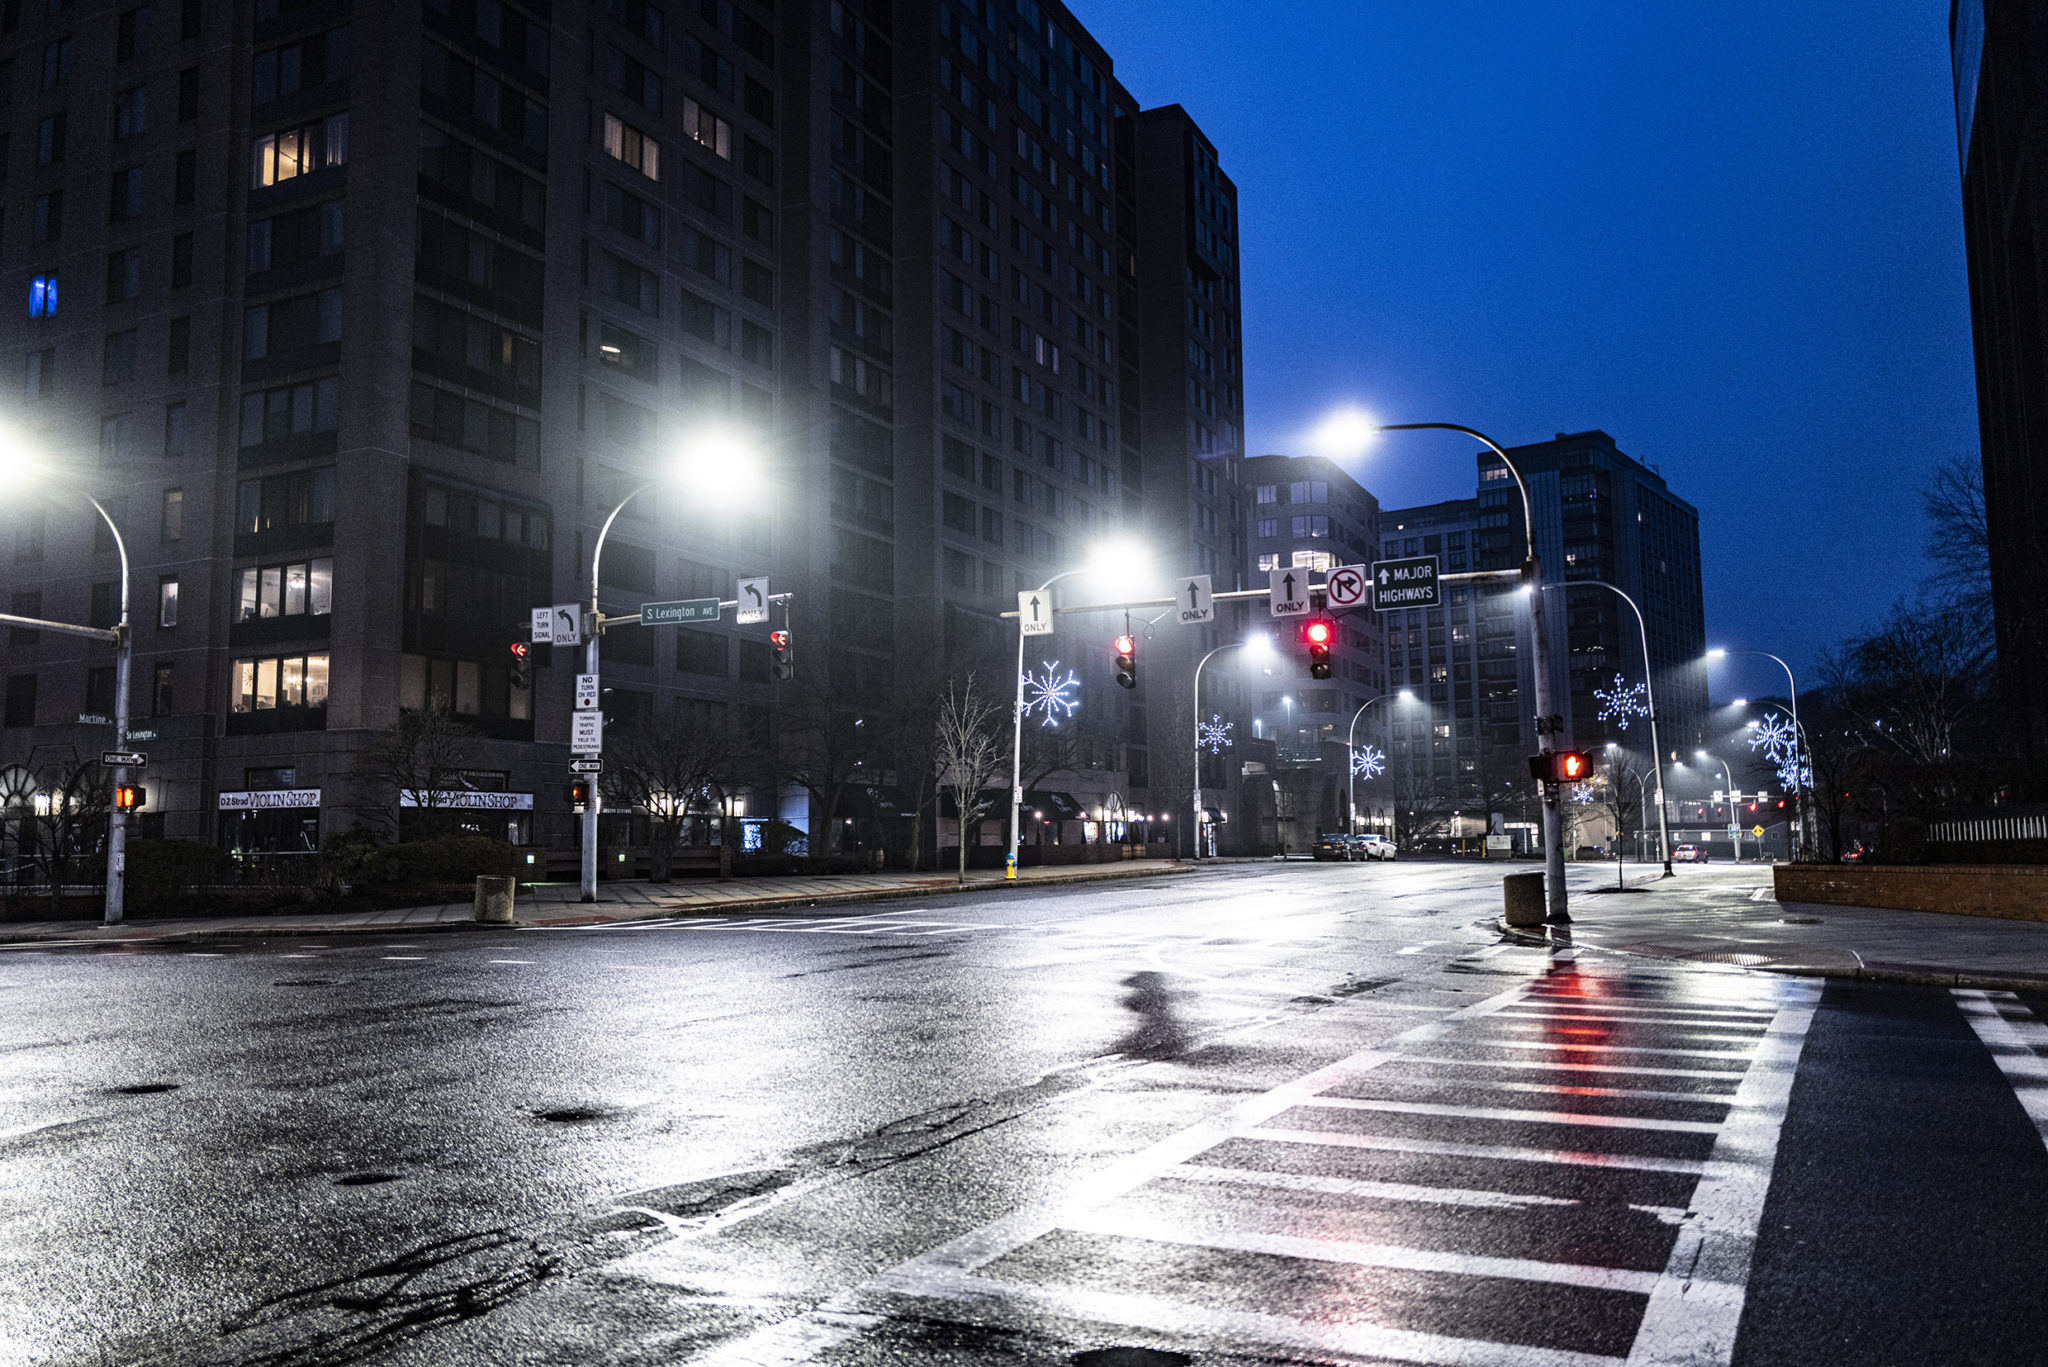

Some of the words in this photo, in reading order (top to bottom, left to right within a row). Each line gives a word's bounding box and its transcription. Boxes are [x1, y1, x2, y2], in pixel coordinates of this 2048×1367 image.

[1394, 566, 1432, 581] MAJOR
[1379, 587, 1433, 603] HIGHWAYS
[1276, 602, 1304, 612] ONLY
[537, 611, 548, 619] LEFT
[655, 607, 695, 621] Lexington
[703, 607, 713, 615] AVE
[742, 610, 764, 619] ONLY
[1182, 609, 1208, 620] ONLY
[1024, 623, 1046, 632] ONLY
[557, 634, 576, 642] ONLY
[78, 713, 106, 724] Martine
[133, 730, 153, 741] Lexington
[231, 797, 248, 806] Strad
[286, 791, 317, 807] SHOP
